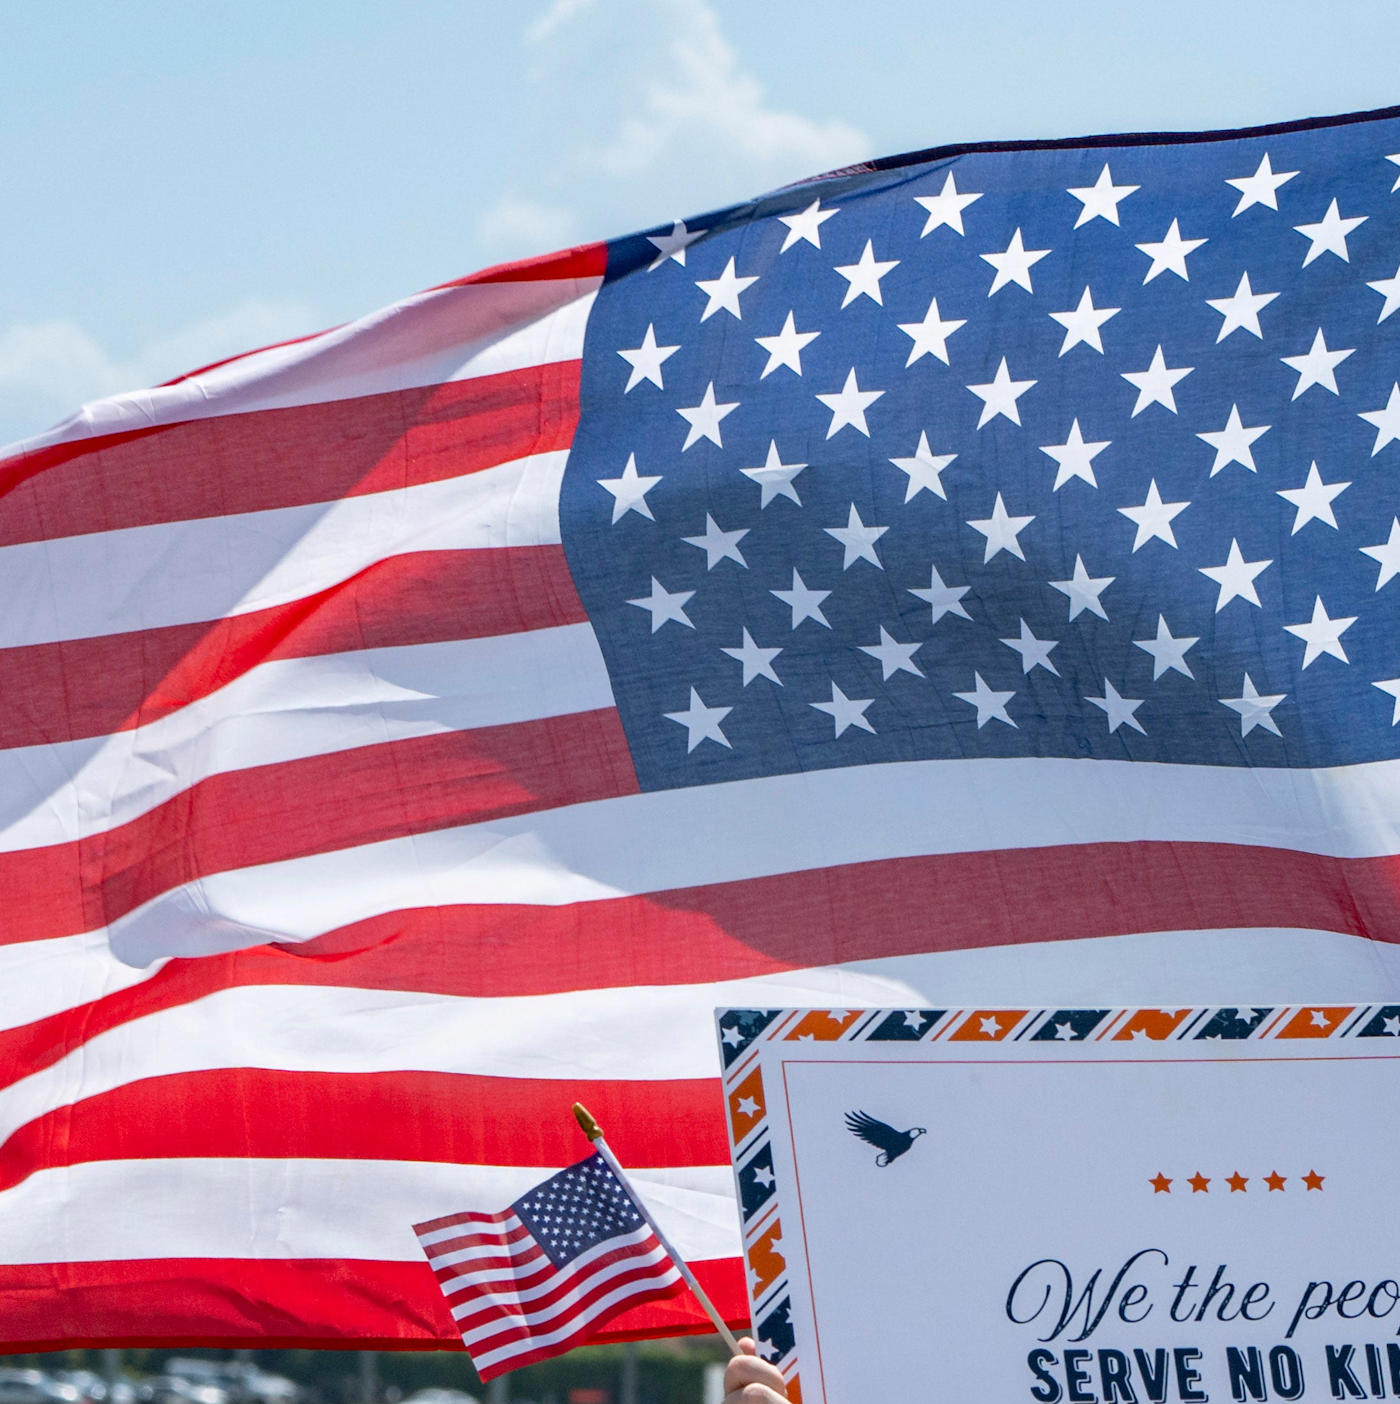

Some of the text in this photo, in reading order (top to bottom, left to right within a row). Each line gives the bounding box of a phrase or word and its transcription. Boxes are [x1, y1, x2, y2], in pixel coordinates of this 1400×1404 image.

[1006, 1247, 1168, 1342] We
[1171, 1265, 1273, 1323] the
[1029, 1346, 1209, 1404] SERVE
[1227, 1344, 1306, 1402] NO
